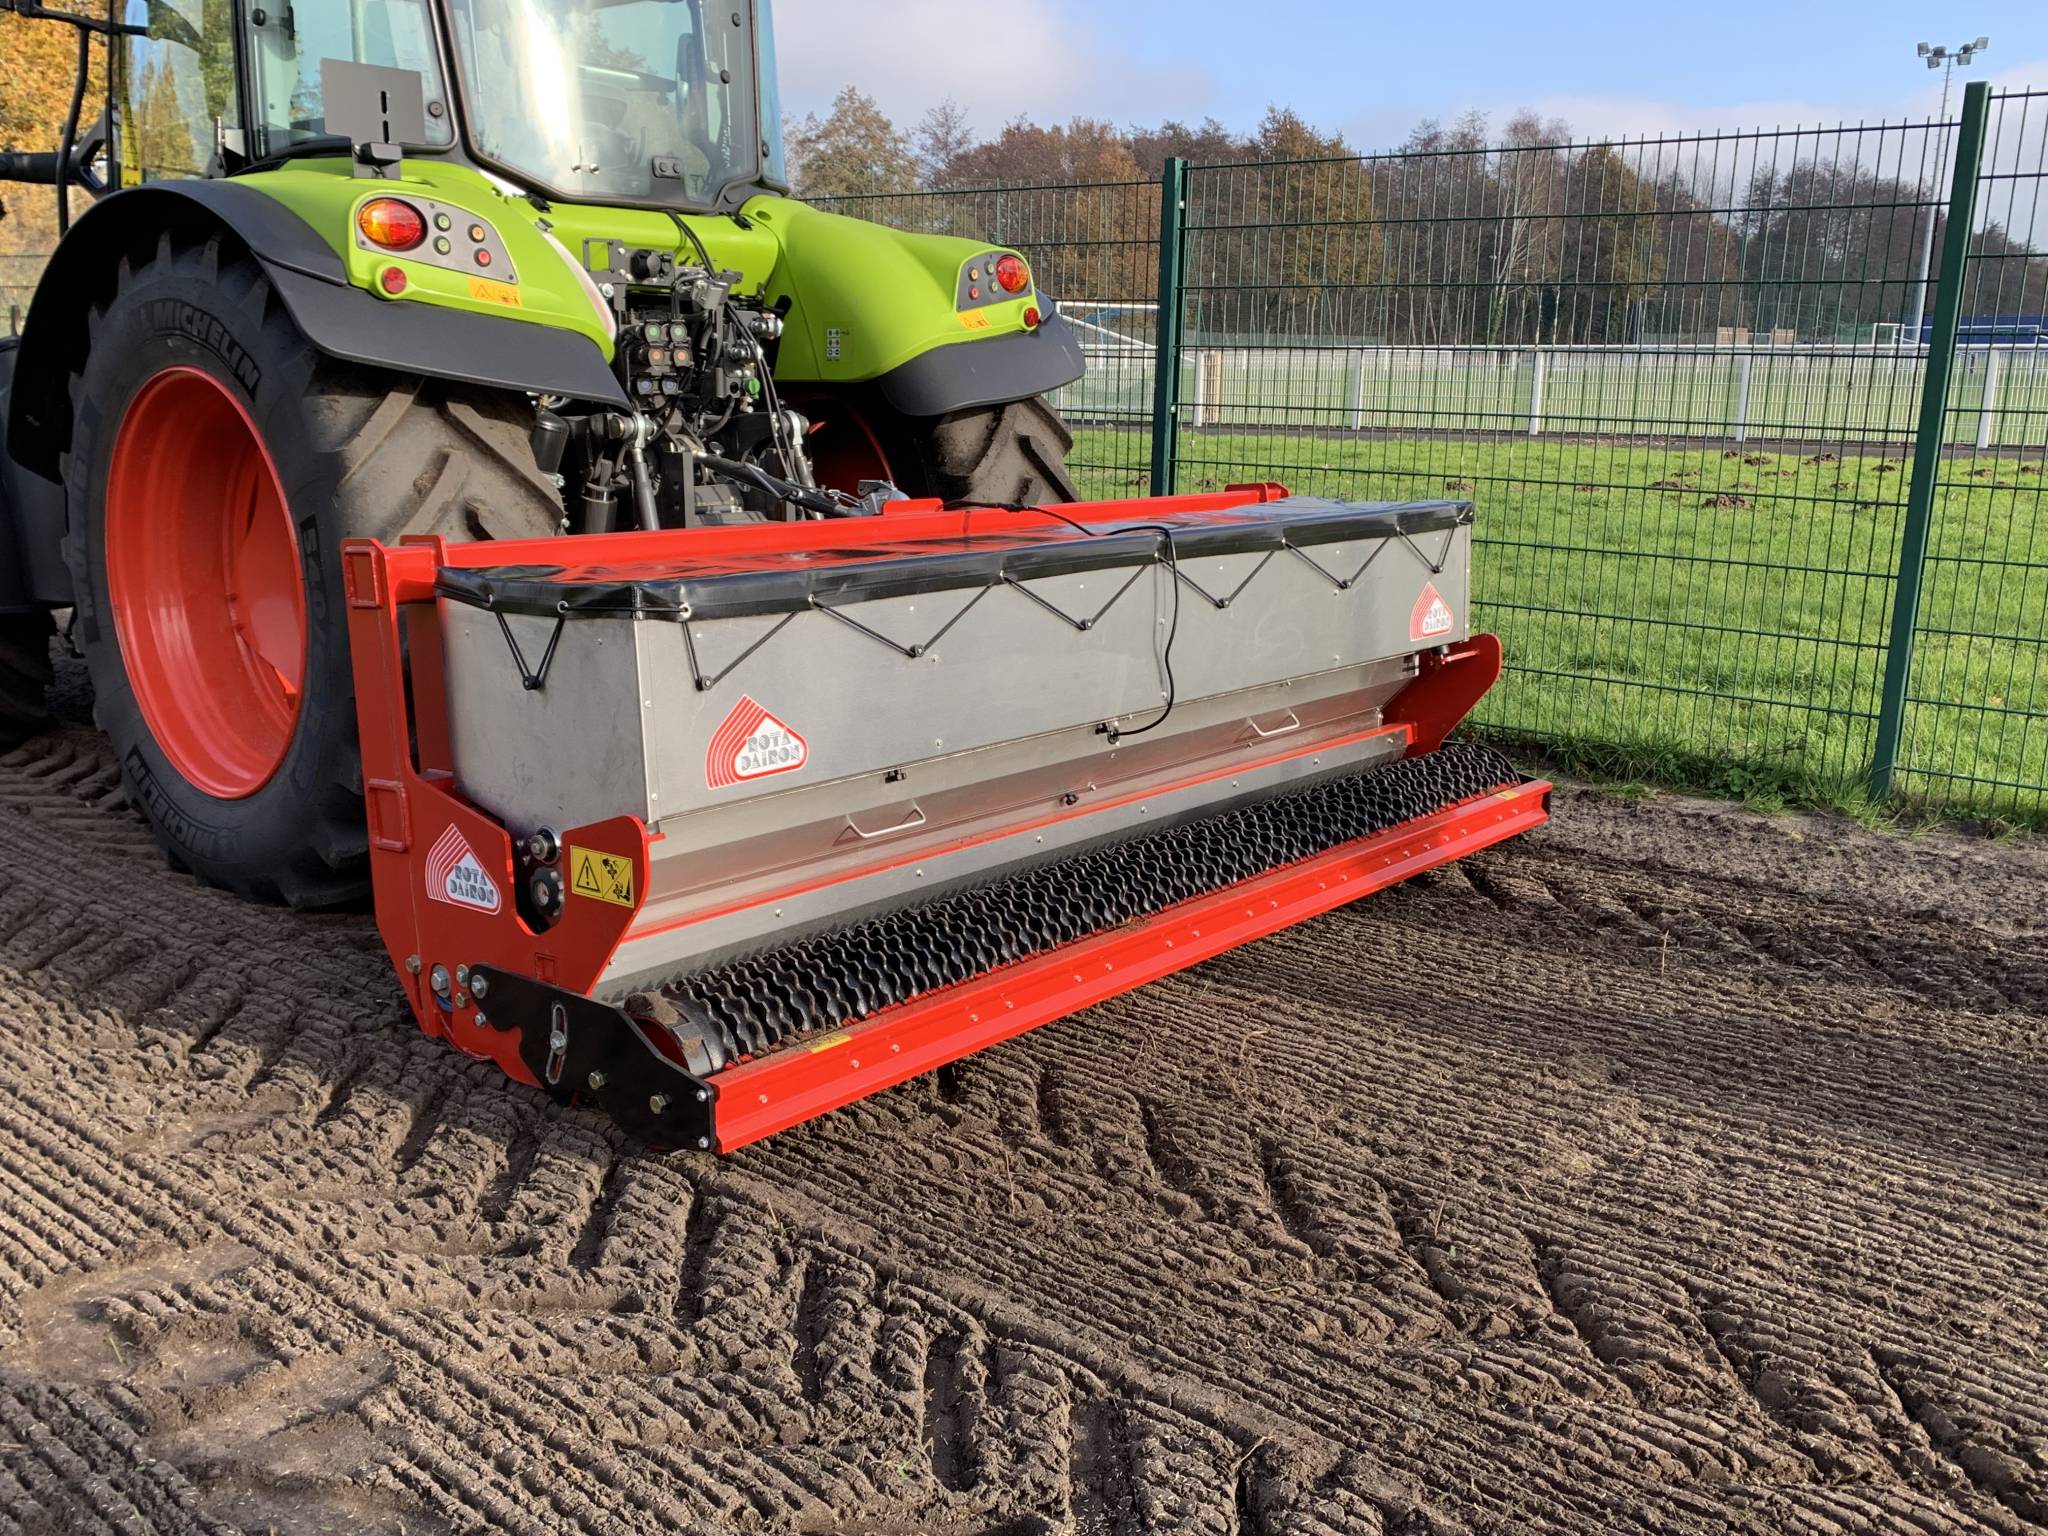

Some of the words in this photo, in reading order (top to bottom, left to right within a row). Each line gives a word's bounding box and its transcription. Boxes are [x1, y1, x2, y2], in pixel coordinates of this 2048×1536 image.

[153, 301, 260, 389] MICHELIN
[748, 730, 791, 753] ROTA
[126, 754, 217, 858] MICHELIN
[454, 864, 488, 887] ROTA
